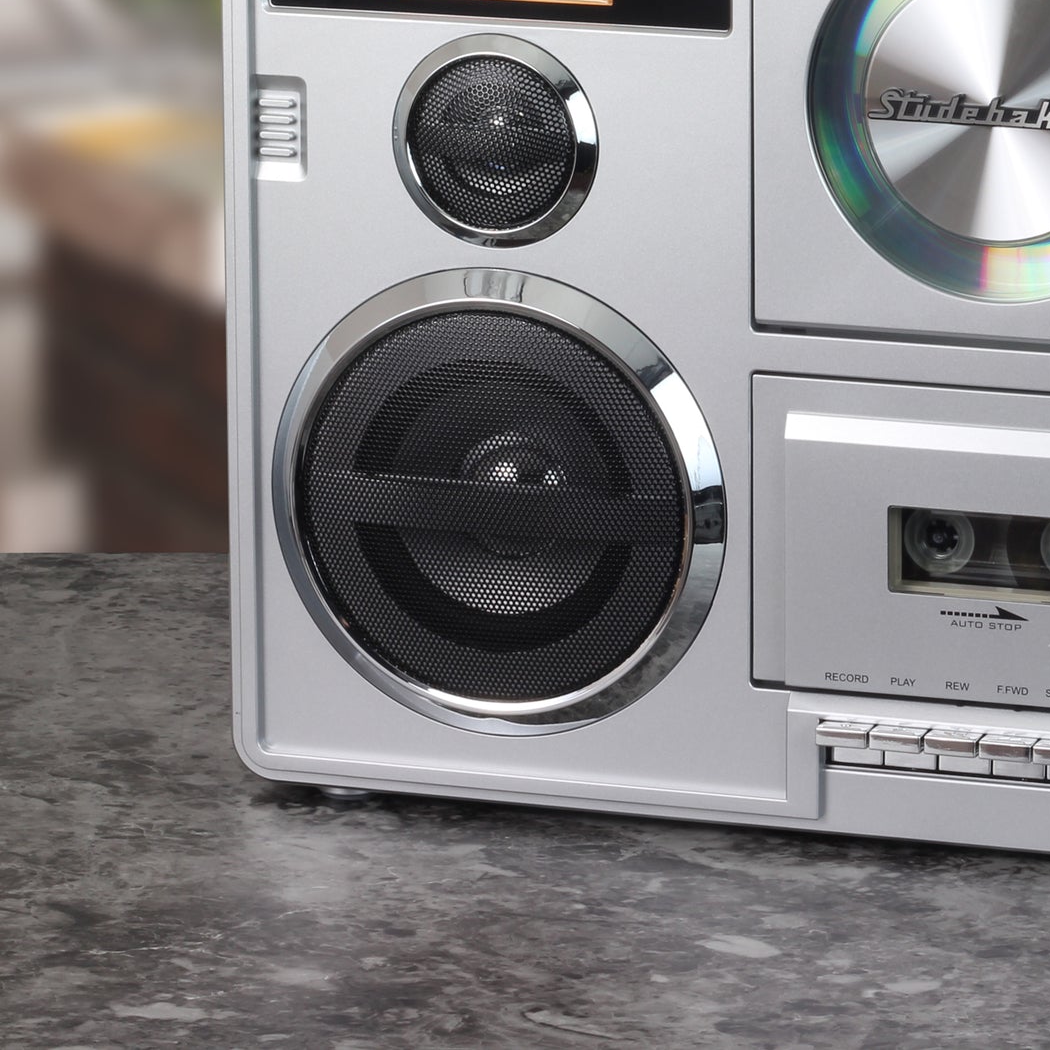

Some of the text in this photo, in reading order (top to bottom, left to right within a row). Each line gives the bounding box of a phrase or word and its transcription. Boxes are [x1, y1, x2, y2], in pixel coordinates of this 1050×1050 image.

[950, 619, 1022, 631] AUTO STOP
[824, 671, 869, 684] RECORD
[890, 677, 916, 688] PLAY
[945, 681, 970, 692] REW
[996, 685, 1029, 697] F.FWD
